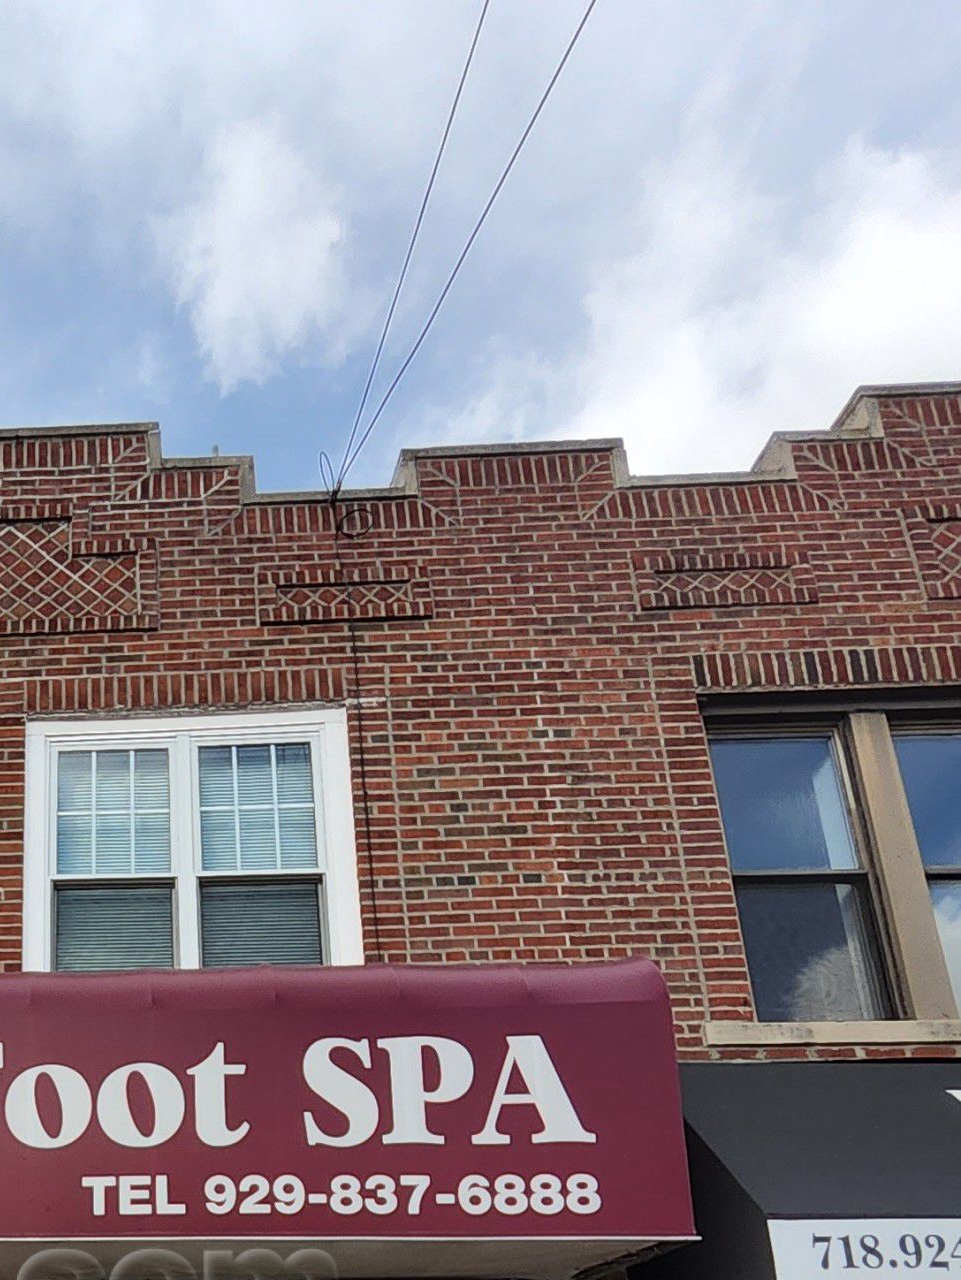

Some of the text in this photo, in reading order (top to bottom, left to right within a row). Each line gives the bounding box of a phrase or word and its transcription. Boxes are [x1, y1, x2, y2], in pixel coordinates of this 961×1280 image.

[302, 1034, 597, 1149] SPA
[80, 1173, 603, 1217] TEL 929-837-6888
